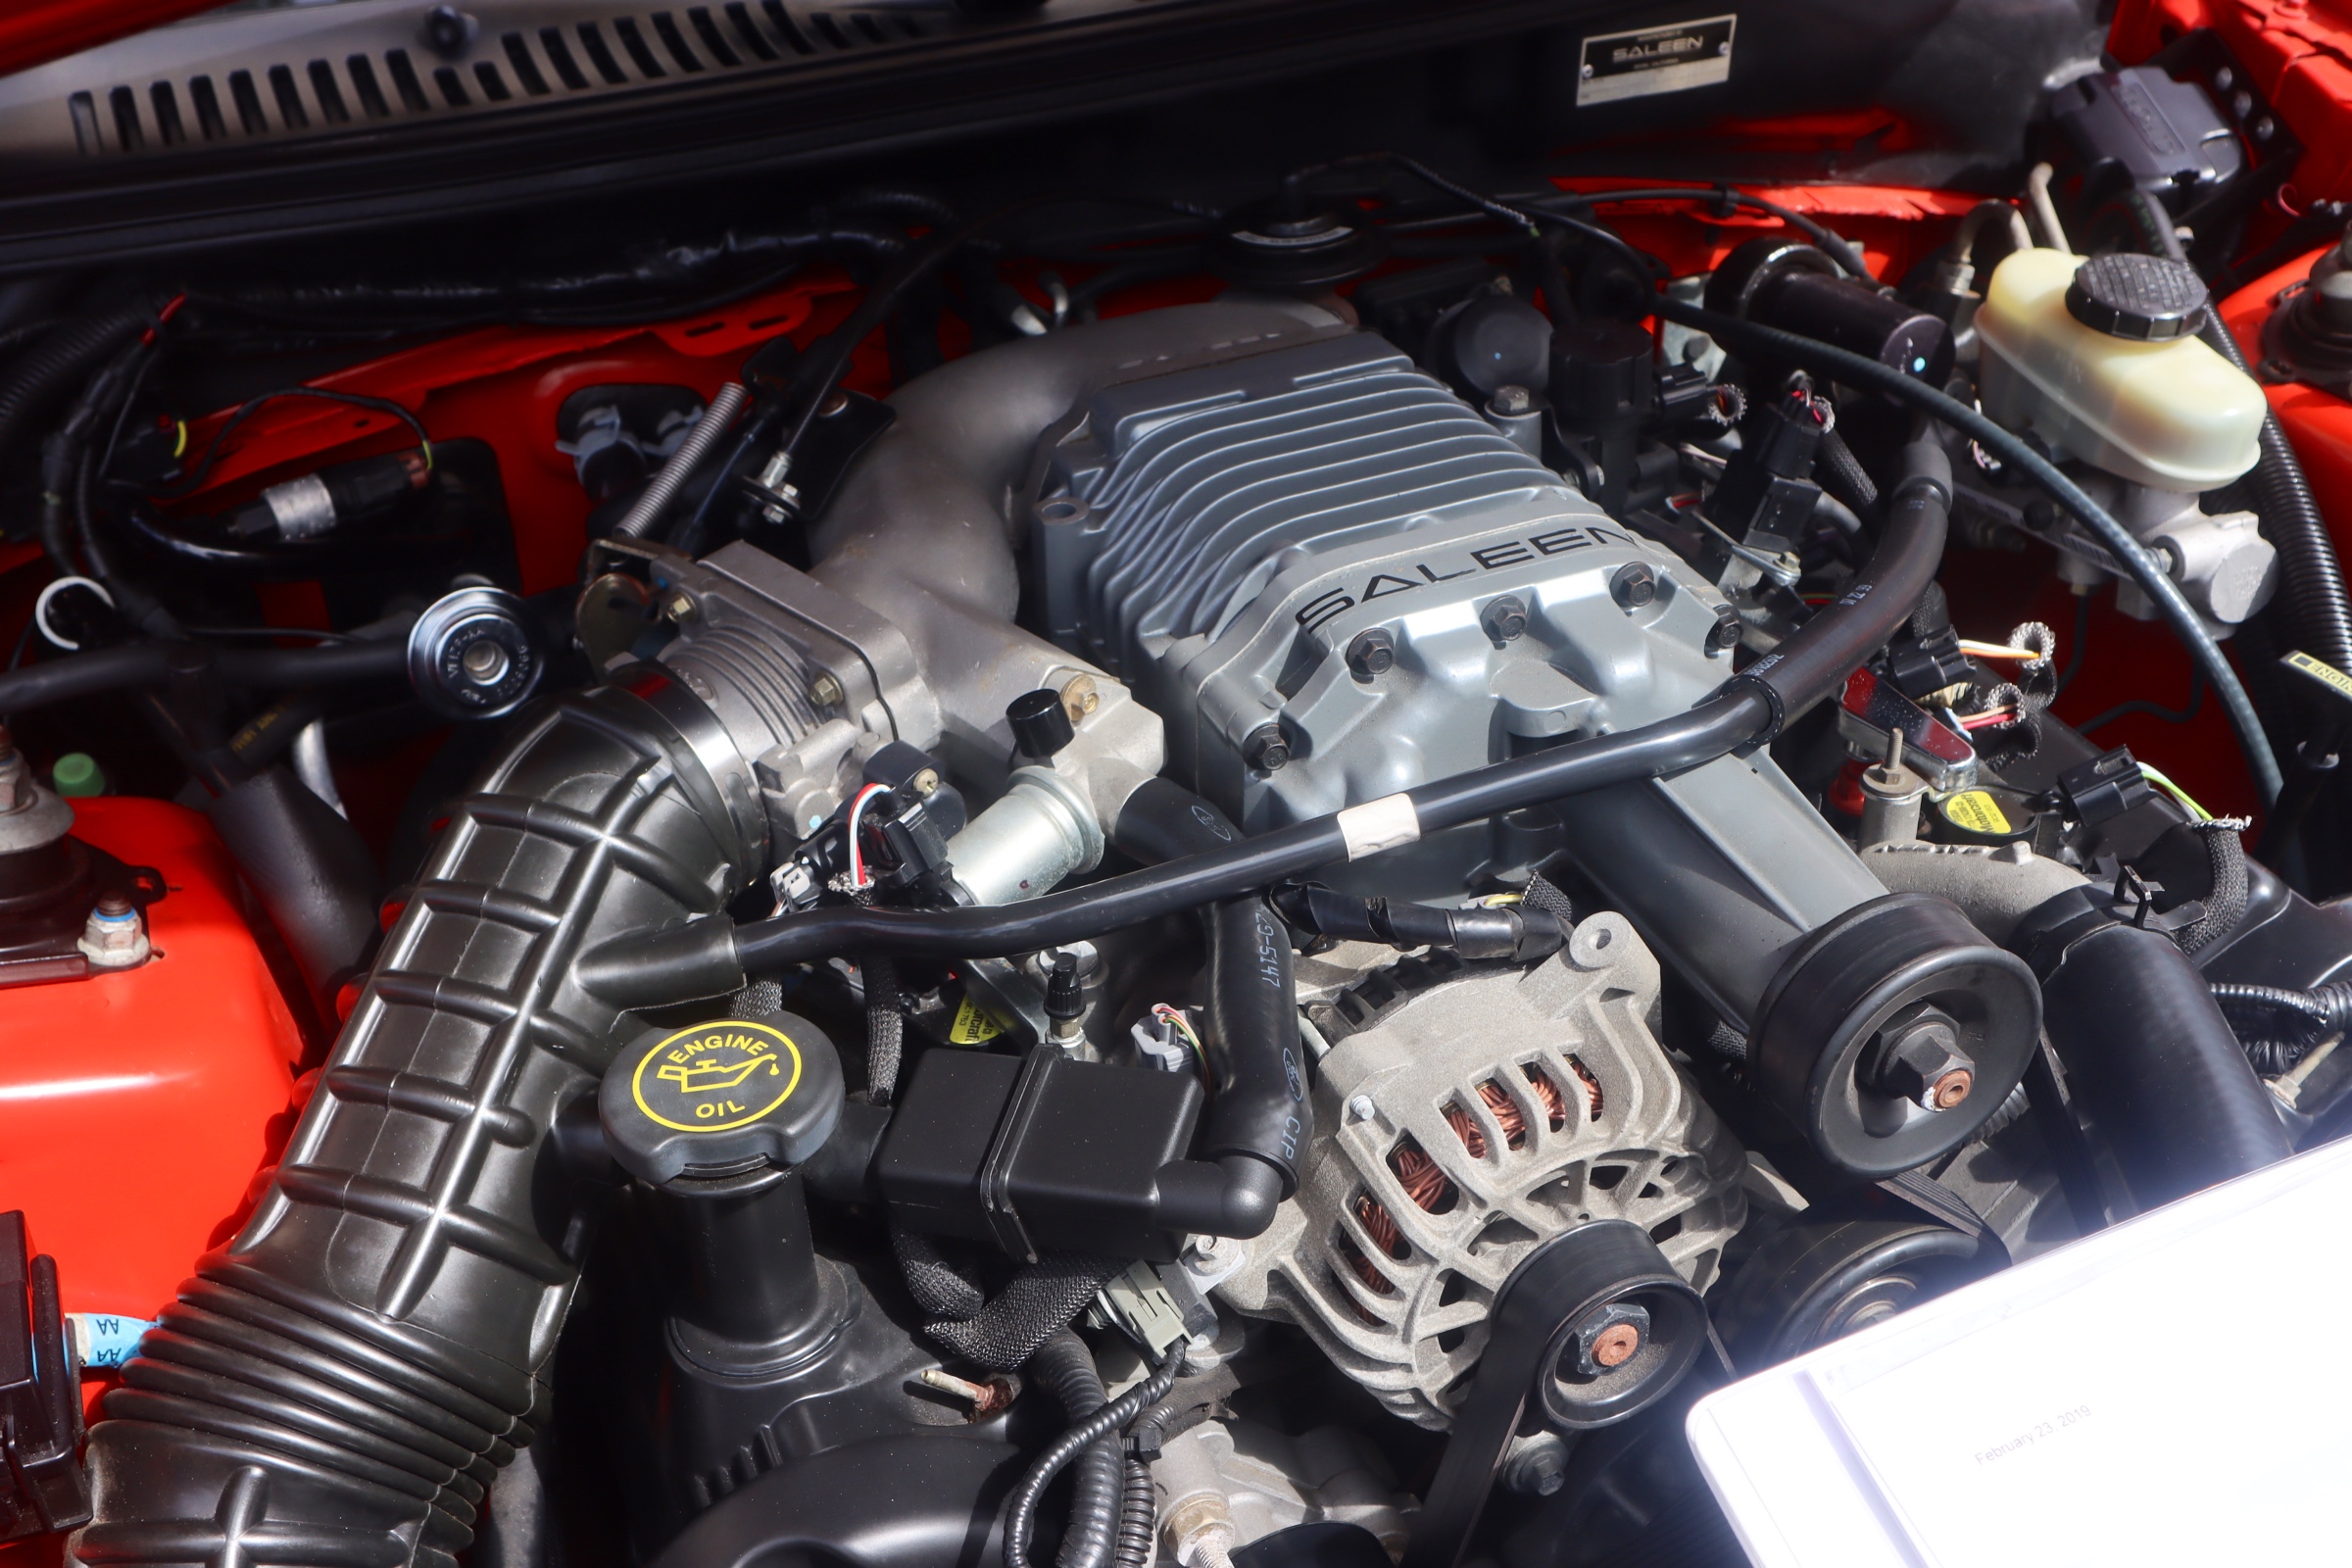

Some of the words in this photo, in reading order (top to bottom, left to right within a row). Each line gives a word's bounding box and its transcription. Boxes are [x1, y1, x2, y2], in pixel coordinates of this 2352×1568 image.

[1613, 35, 1704, 63] SALEEN
[1295, 527, 1639, 634] SALEEN
[667, 1034, 769, 1064] ENGINE
[695, 1100, 746, 1118] OIL
[1281, 1115, 1301, 1160] CIP
[1974, 1432, 2034, 1466] February
[2057, 1404, 2091, 1428] 2019
